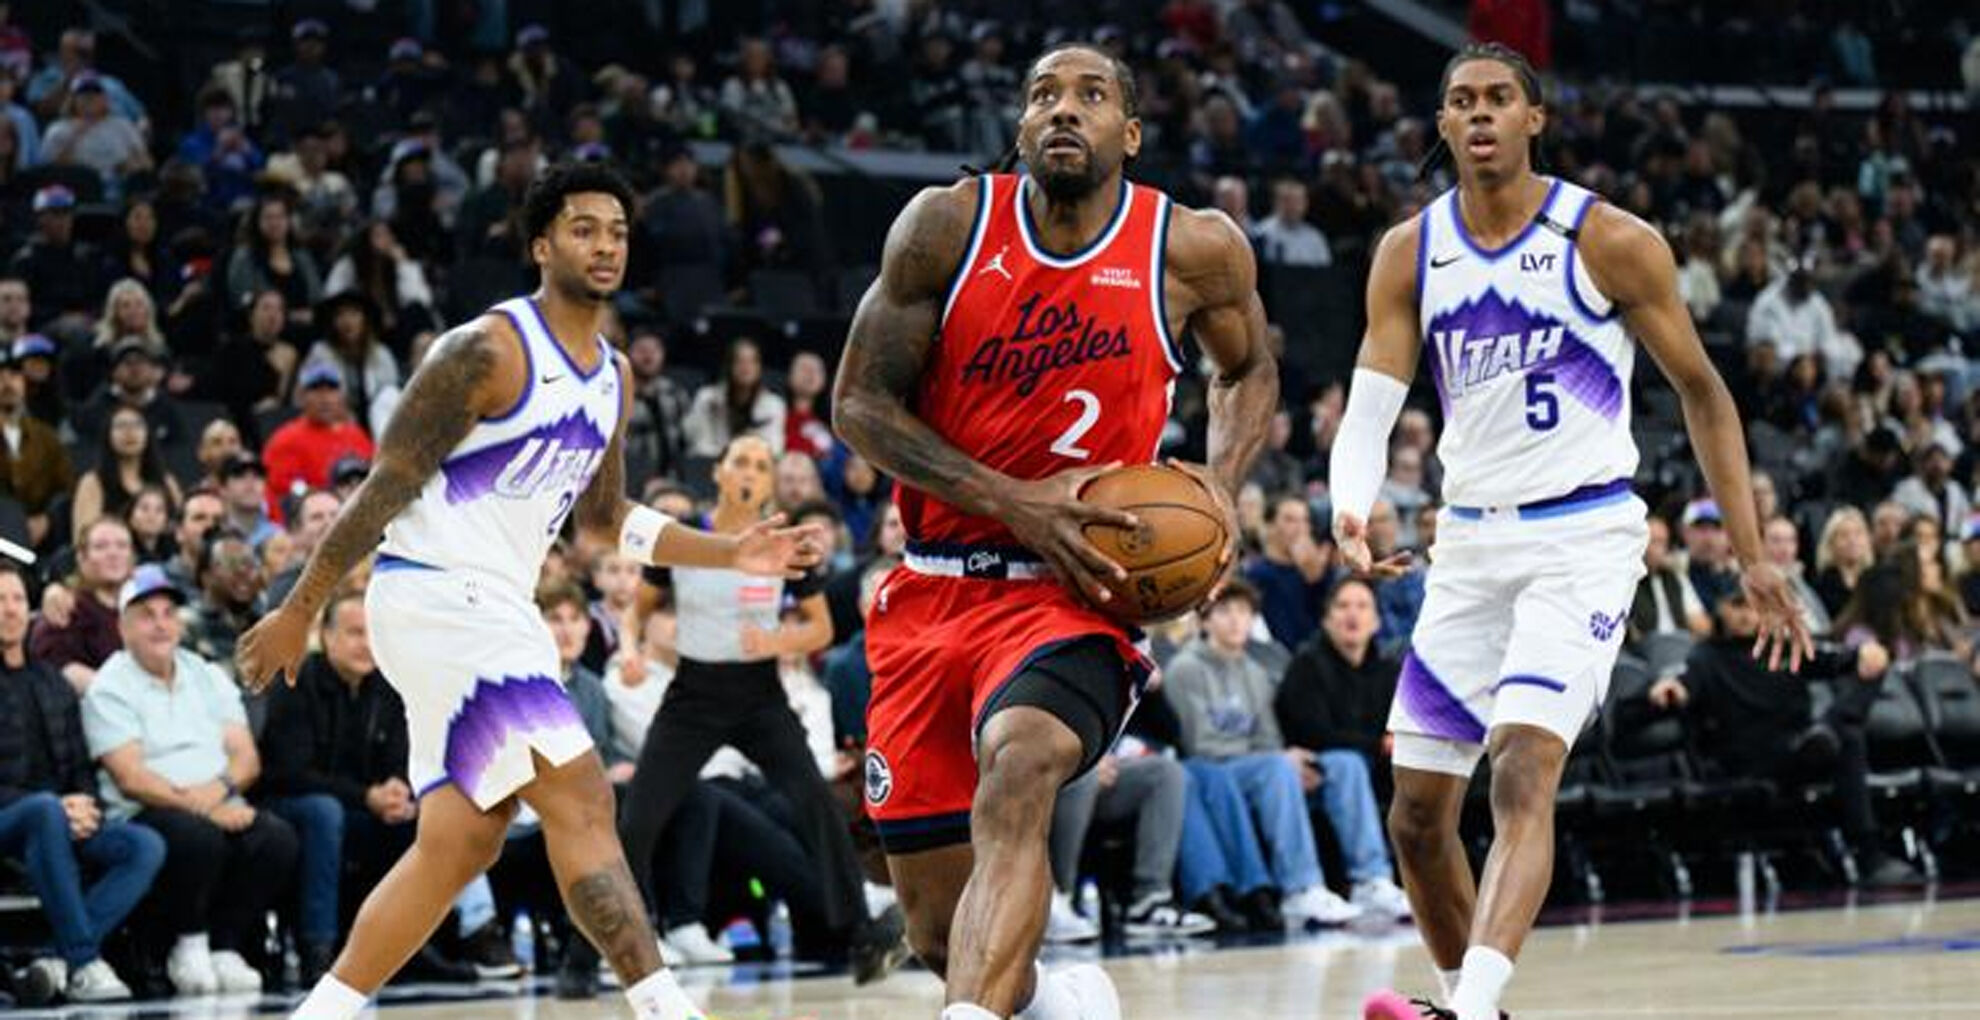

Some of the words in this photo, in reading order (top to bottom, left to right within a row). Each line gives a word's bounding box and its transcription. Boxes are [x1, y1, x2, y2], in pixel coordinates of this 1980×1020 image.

[1520, 253, 1556, 271] LVT
[1011, 292, 1081, 343] Los
[962, 316, 1131, 397] Angeles
[1050, 389, 1101, 459] 2
[1525, 373, 1559, 431] 5
